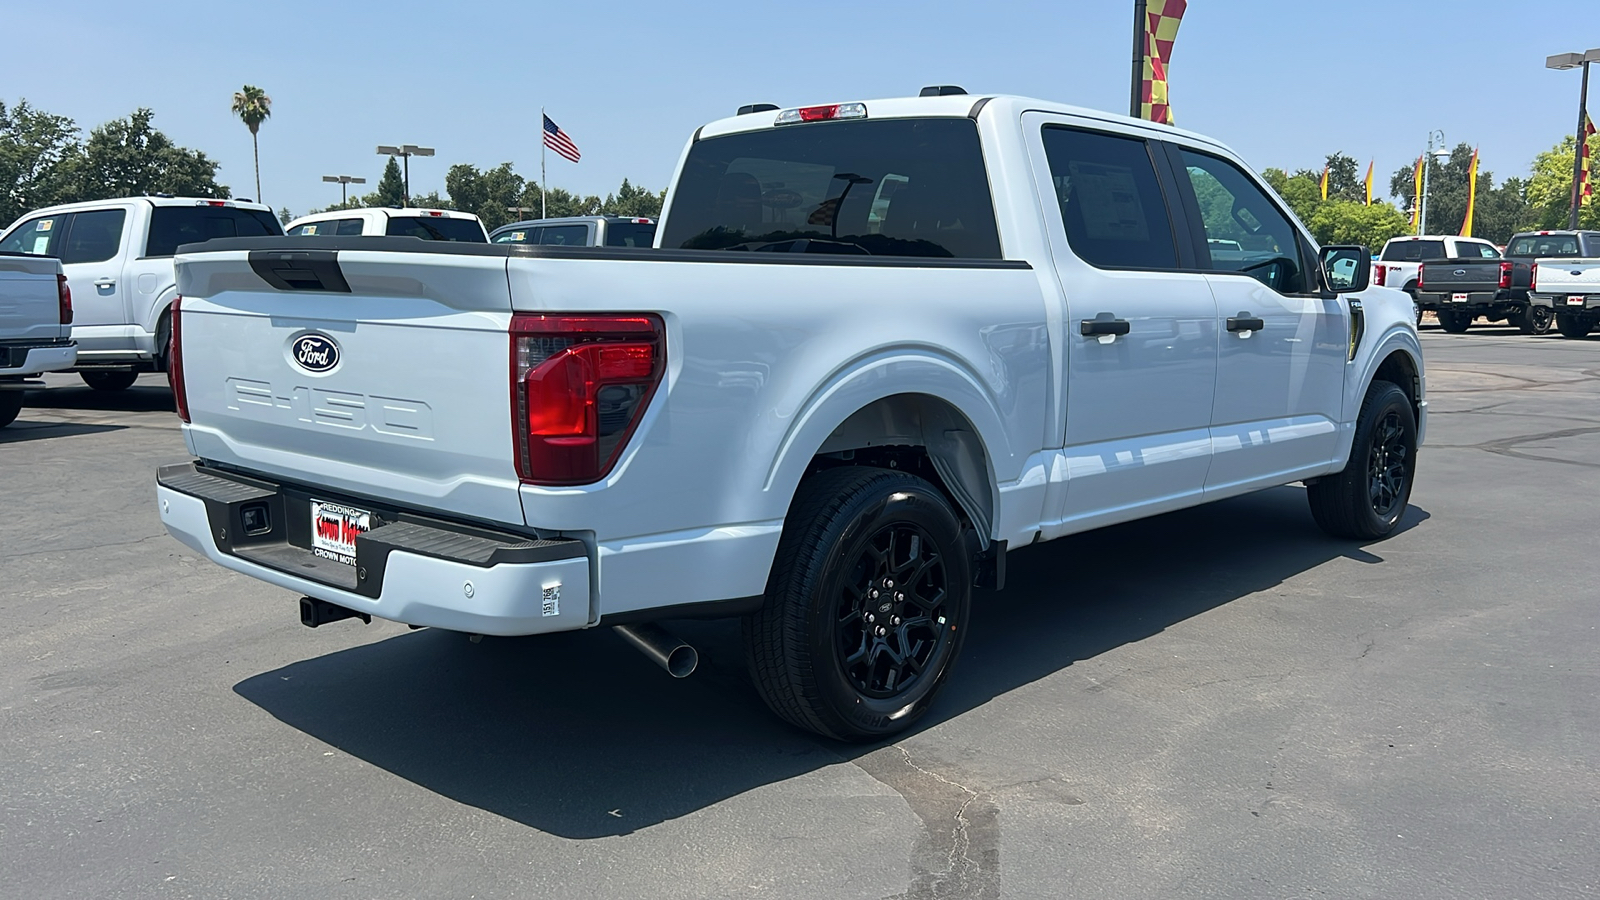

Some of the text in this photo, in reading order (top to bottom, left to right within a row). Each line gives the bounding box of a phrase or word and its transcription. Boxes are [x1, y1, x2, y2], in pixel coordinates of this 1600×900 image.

[298, 339, 330, 366] Ford
[225, 376, 435, 441] F-150
[323, 503, 355, 516] REDDING
[316, 515, 339, 542] Crown
[314, 548, 357, 566] CROWN MOTO
